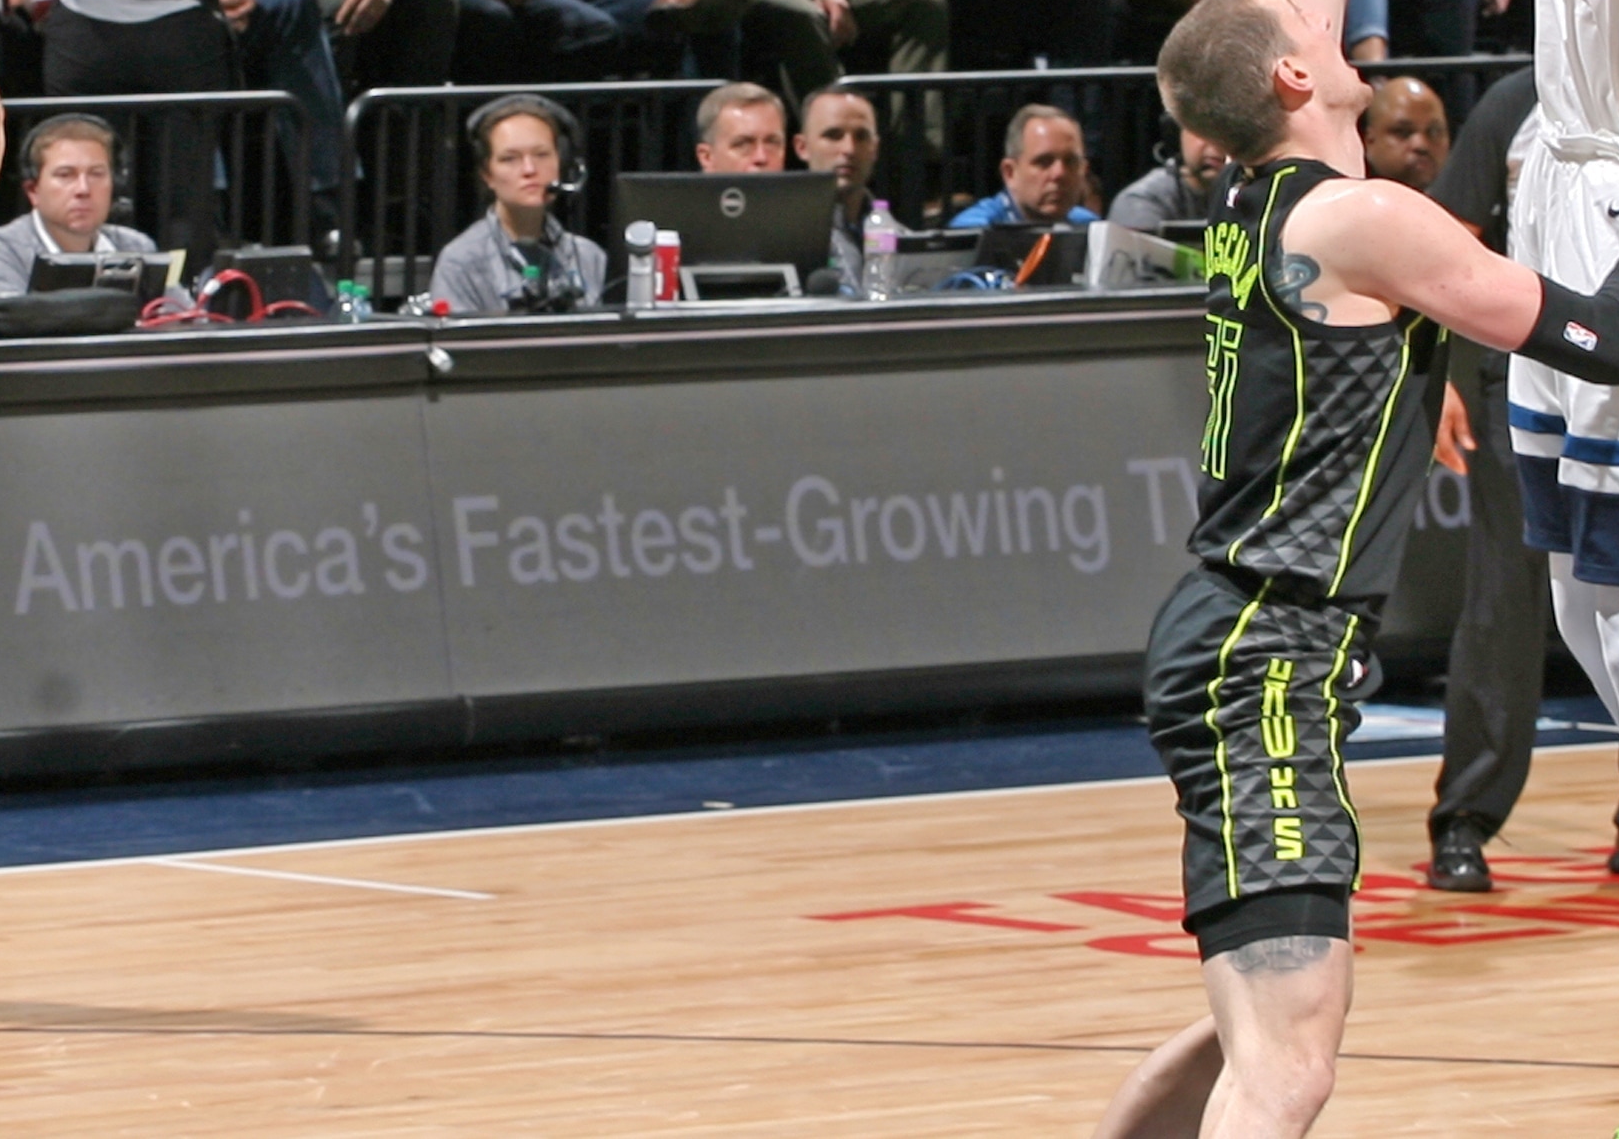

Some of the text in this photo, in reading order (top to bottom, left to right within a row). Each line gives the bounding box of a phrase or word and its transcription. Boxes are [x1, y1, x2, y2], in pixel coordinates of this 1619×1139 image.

[15, 502, 428, 615] America's
[452, 467, 1111, 587] Fastest-Growing
[1261, 658, 1305, 860] HAWKS
